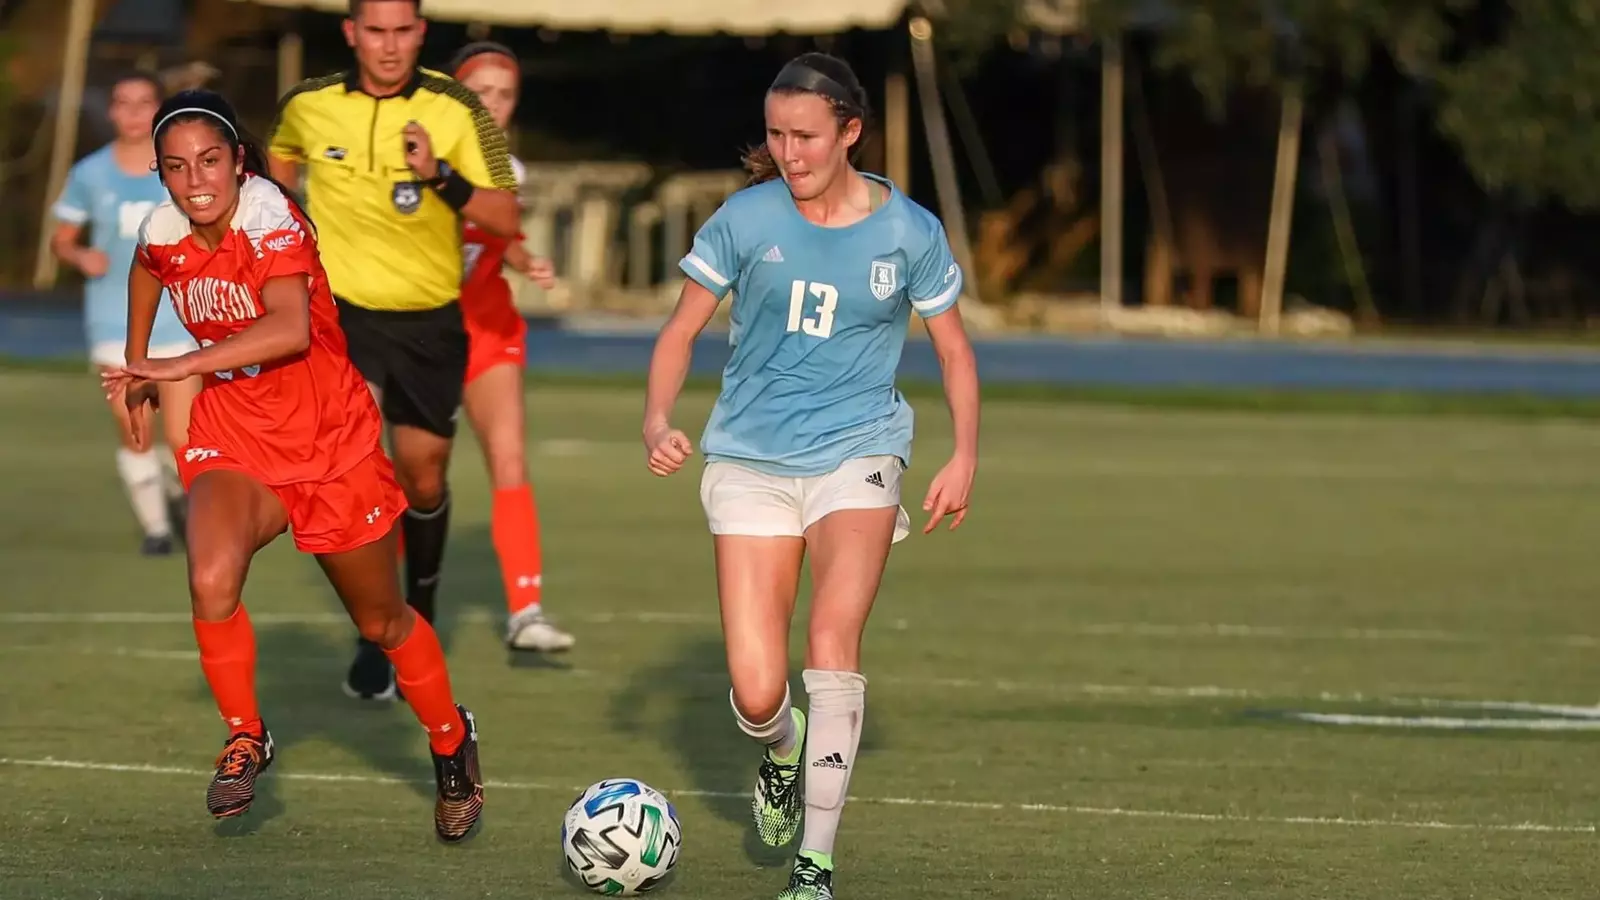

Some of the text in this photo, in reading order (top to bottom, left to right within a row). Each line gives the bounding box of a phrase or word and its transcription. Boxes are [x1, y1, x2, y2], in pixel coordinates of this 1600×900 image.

[265, 234, 295, 251] WAC
[187, 277, 257, 320] HOUSTON
[786, 280, 838, 338] 13
[812, 760, 848, 770] adidas
